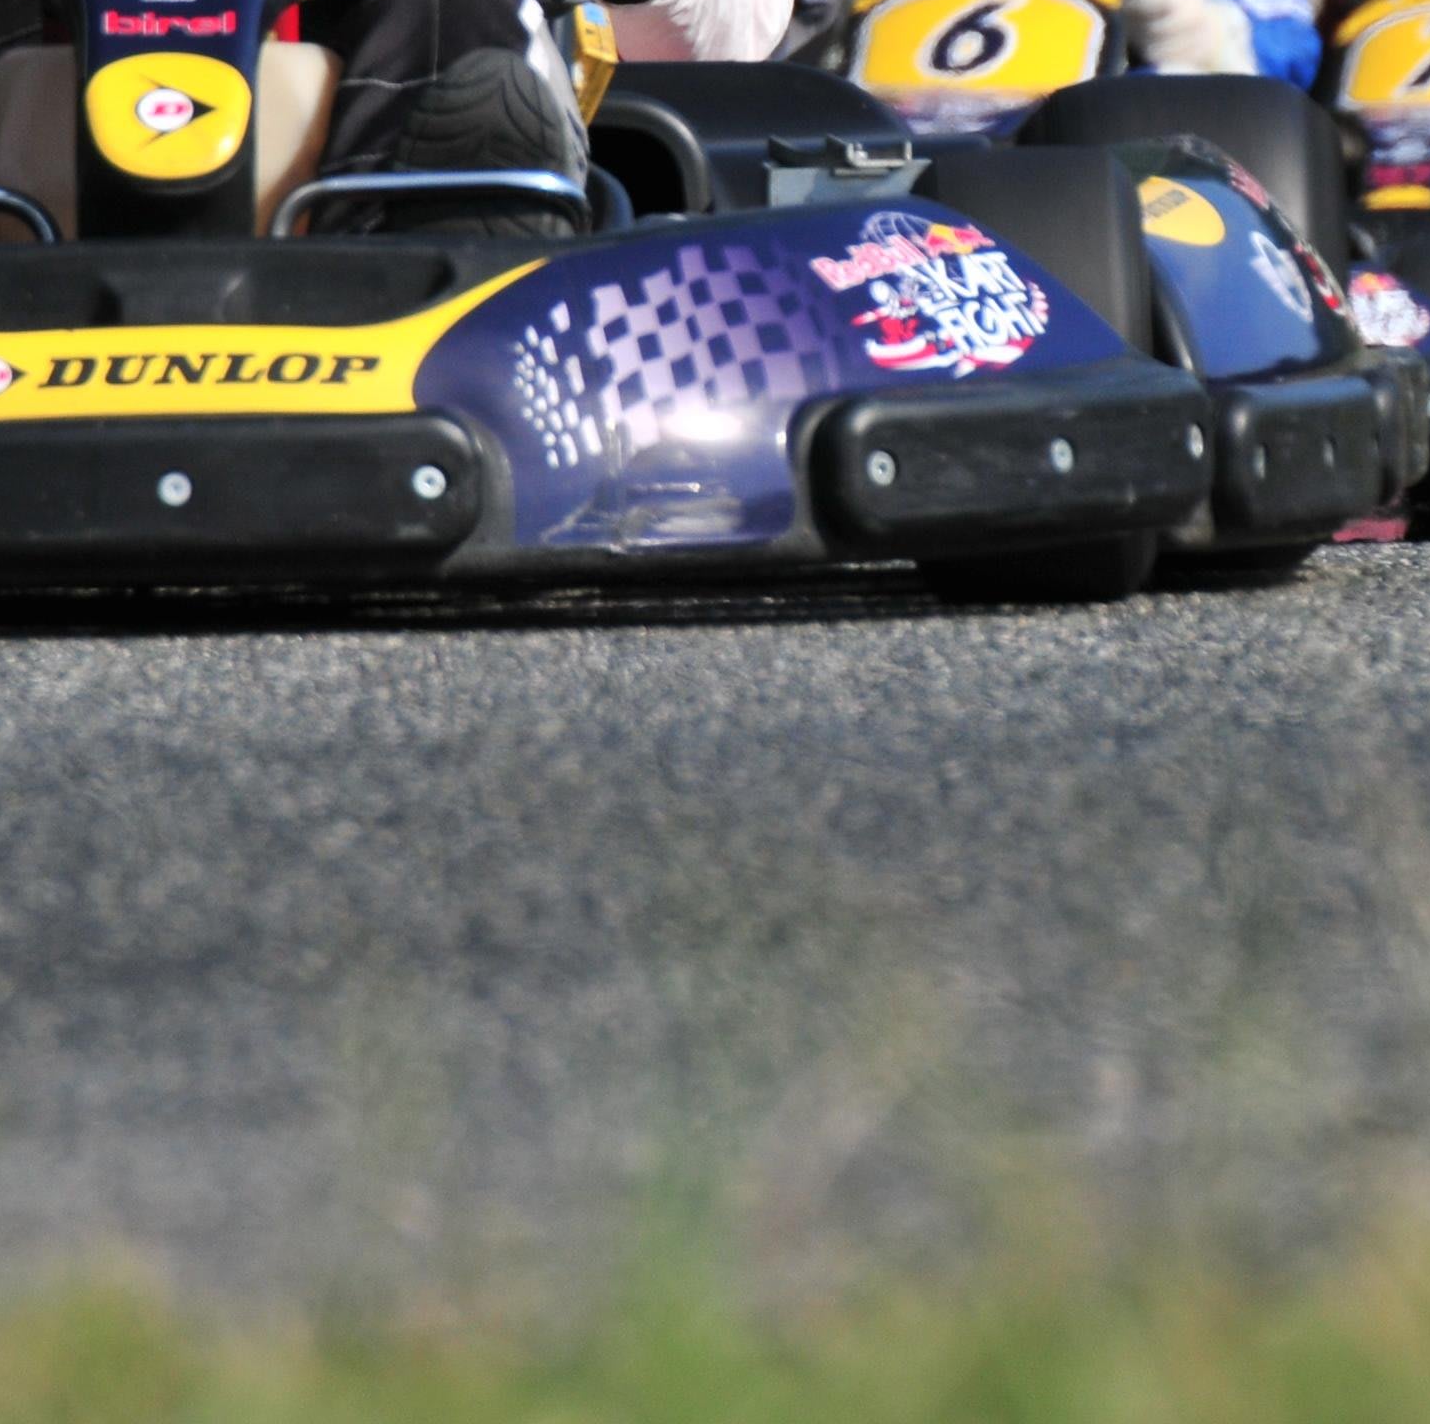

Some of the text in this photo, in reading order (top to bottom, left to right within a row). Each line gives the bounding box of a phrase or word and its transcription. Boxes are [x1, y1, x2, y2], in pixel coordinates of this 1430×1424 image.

[104, 10, 238, 35] birel
[909, 251, 1029, 301] KART
[937, 291, 1047, 352] FIGHT
[37, 353, 381, 389] DUNLOP
